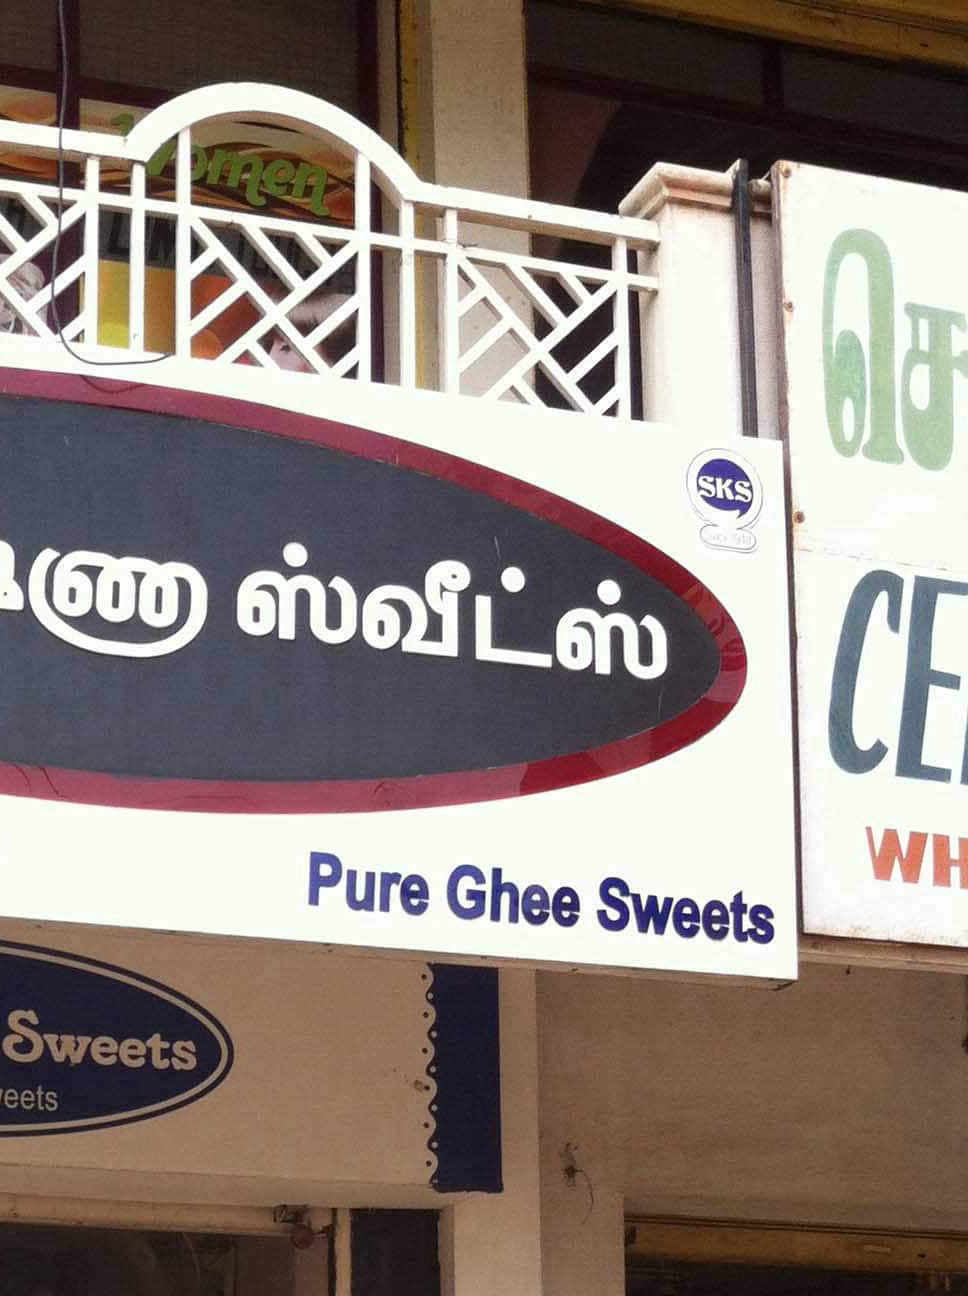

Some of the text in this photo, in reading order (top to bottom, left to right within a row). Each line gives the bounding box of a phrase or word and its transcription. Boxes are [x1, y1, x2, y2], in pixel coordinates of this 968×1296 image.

[697, 475, 753, 503] SKS
[236, 541, 669, 681] ஸ்வீட்ஸ்
[828, 568, 968, 785] CE
[307, 850, 776, 945] Pure Ghee Sweets
[1, 1009, 198, 1072] Sweets
